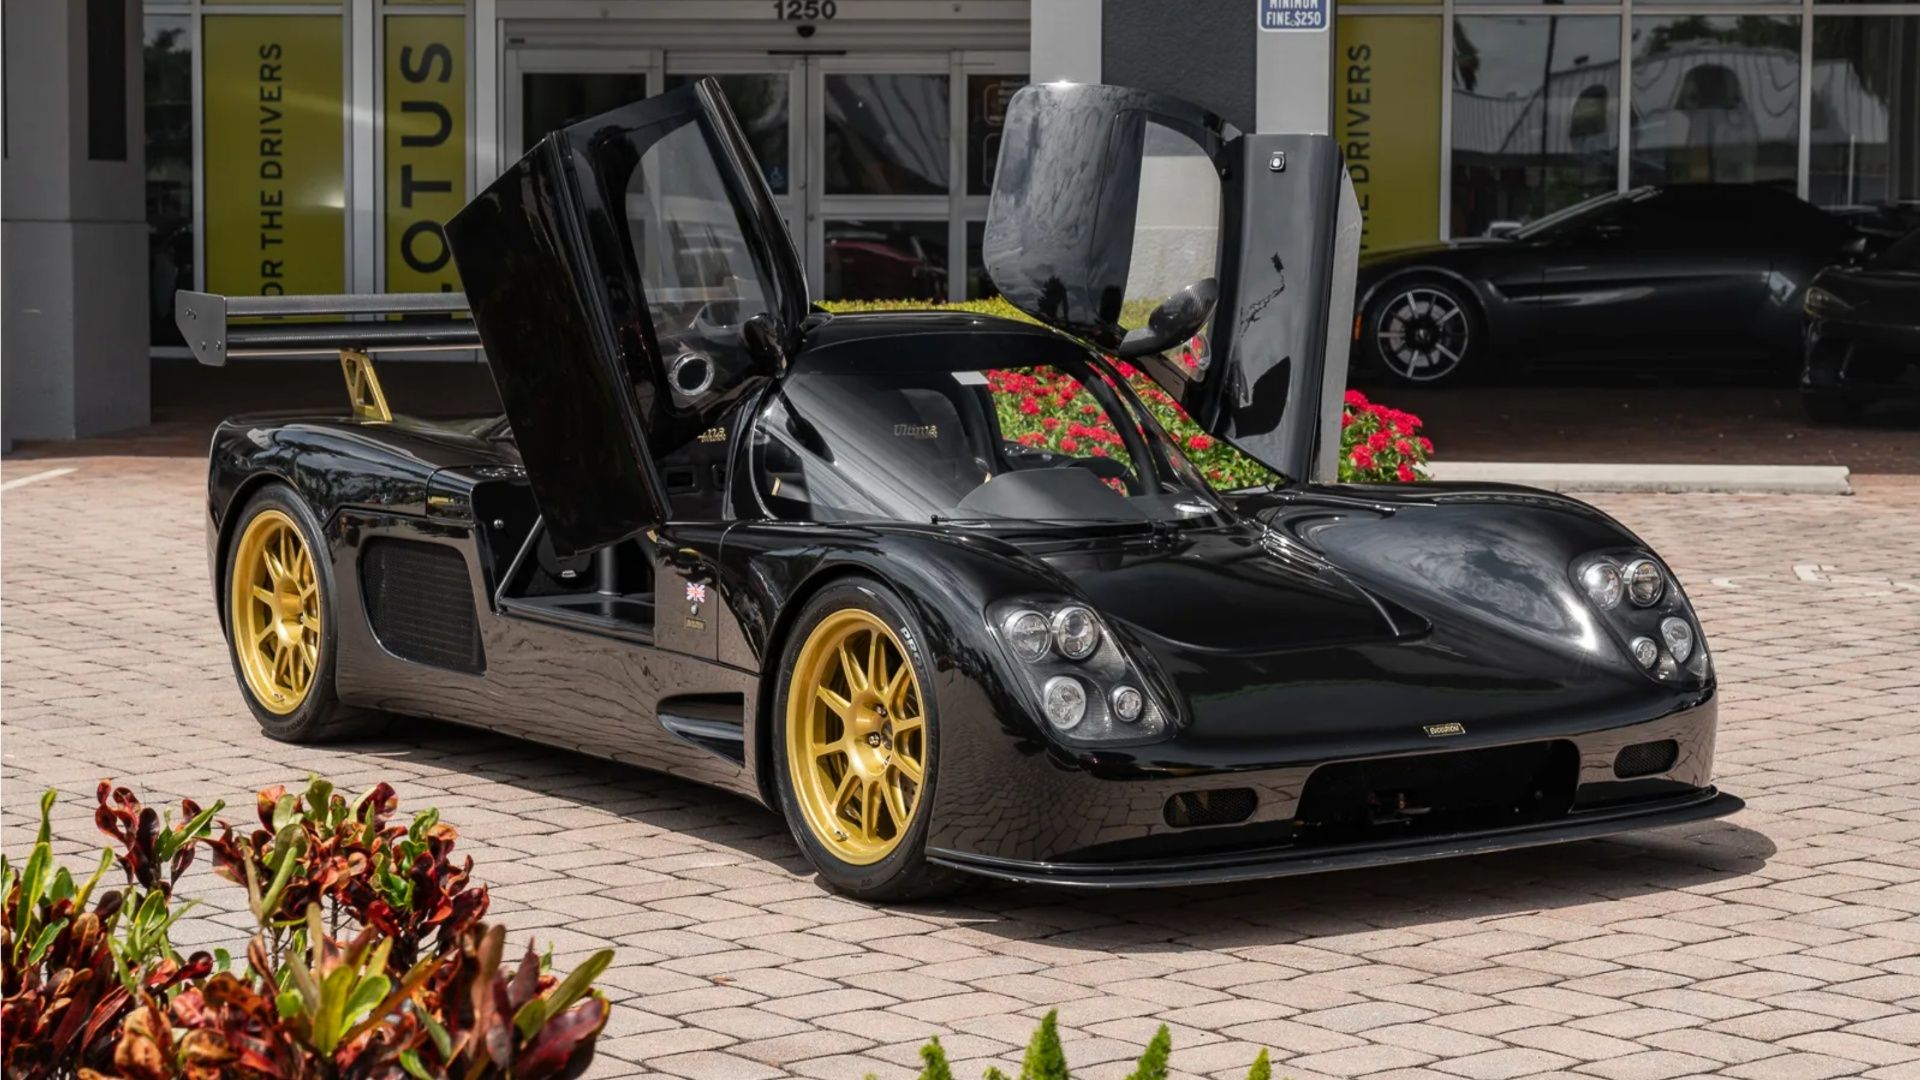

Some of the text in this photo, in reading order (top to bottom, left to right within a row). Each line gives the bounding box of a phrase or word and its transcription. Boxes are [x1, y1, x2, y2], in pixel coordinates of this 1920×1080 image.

[773, 0, 837, 20] 1250
[1269, 0, 1318, 9] MINIMUM
[1266, 10, 1321, 27] FINE $250
[1347, 44, 1371, 183] DRIVERS
[259, 43, 284, 319] OR THE DRIVERS
